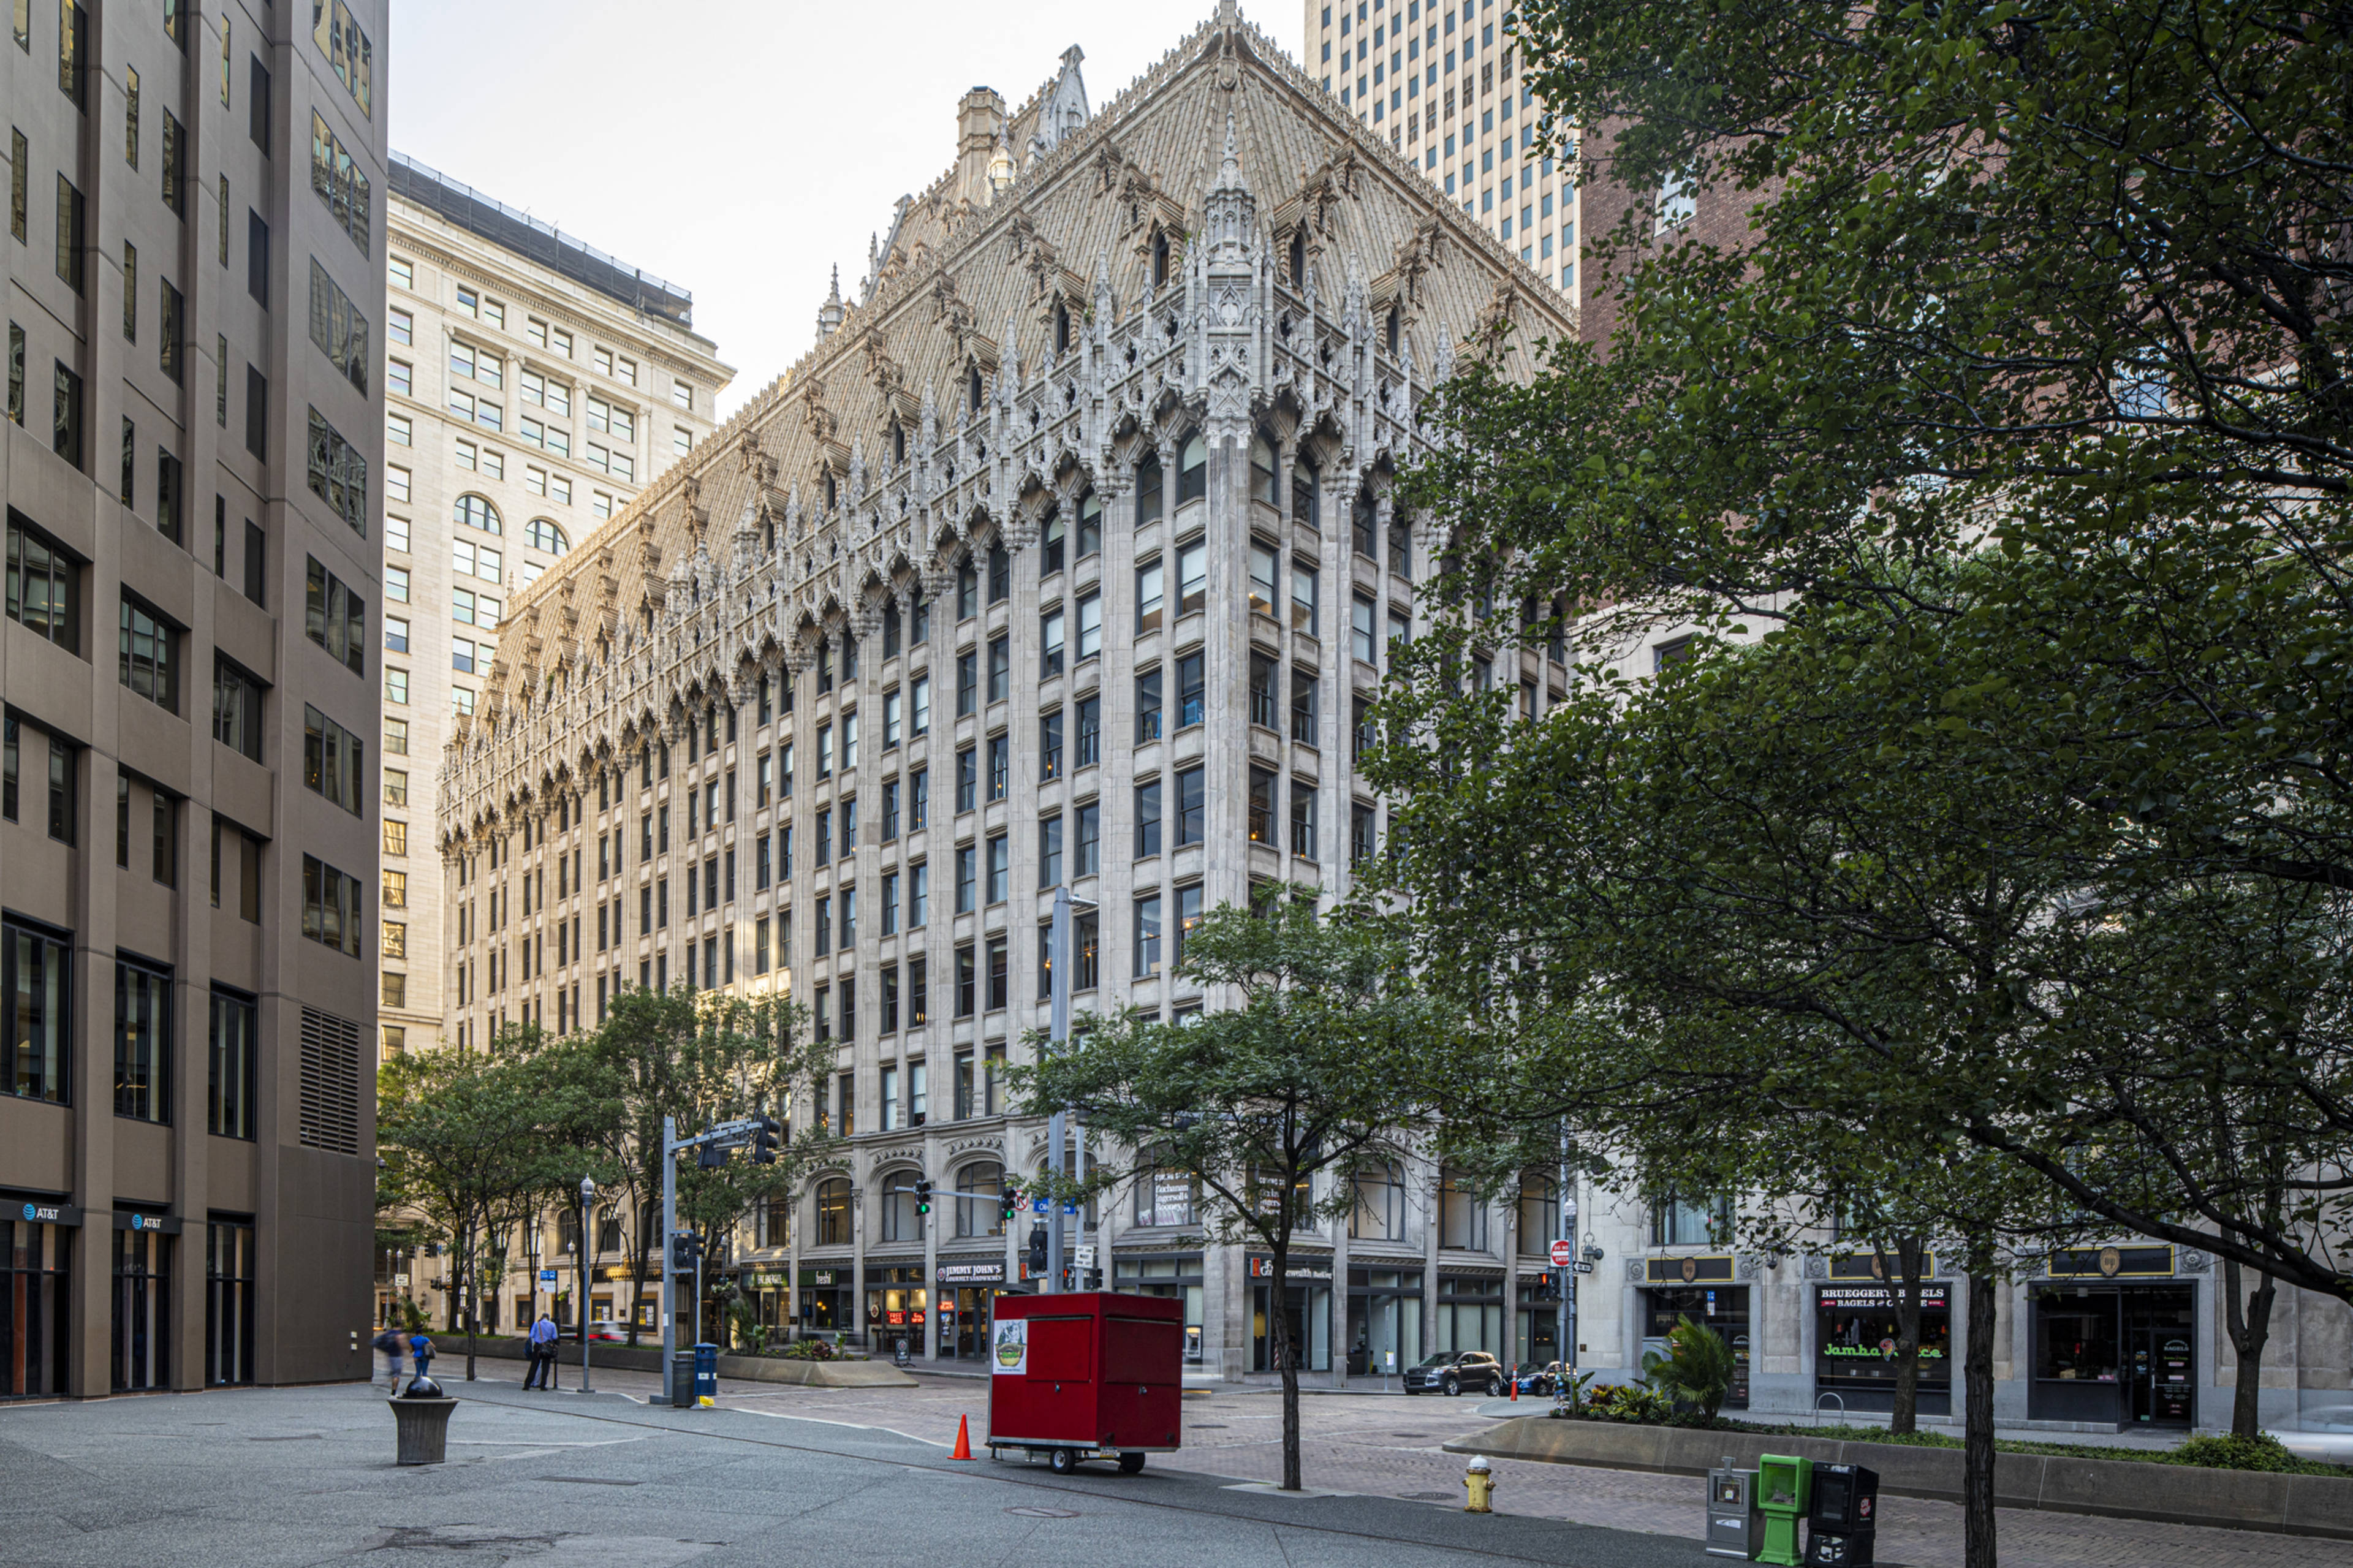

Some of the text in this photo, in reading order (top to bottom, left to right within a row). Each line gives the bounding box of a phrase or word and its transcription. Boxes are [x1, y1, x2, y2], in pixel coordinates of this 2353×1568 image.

[36, 1208, 59, 1220] AT&T
[143, 1218, 162, 1228] AT&T
[946, 1264, 1002, 1277] JIMMY JOHN'S
[1898, 1289, 1944, 1298] BELS
[1824, 1343, 1881, 1357] Jamba
